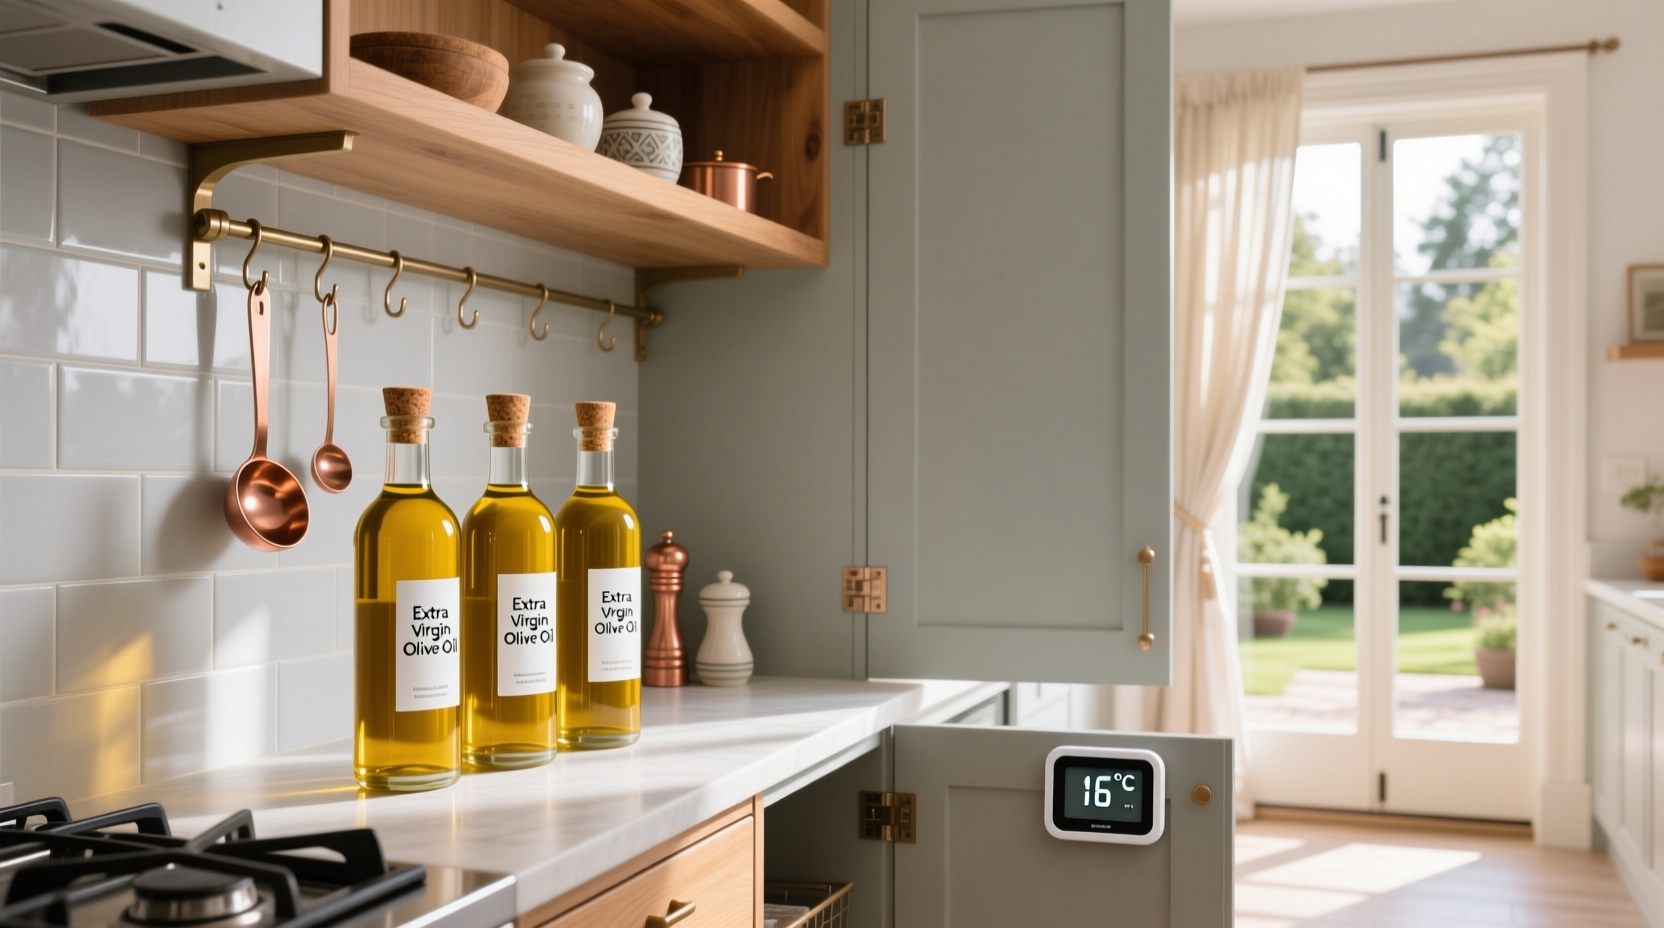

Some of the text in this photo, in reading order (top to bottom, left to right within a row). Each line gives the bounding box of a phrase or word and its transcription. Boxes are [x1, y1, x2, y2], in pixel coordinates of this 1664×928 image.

[513, 597, 546, 610] Extra
[602, 591, 632, 603] Extra
[413, 605, 449, 620] Extra
[511, 614, 549, 630] Virgin
[411, 623, 451, 641] Virgin
[504, 631, 537, 645] Olive
[403, 641, 439, 656] Olive
